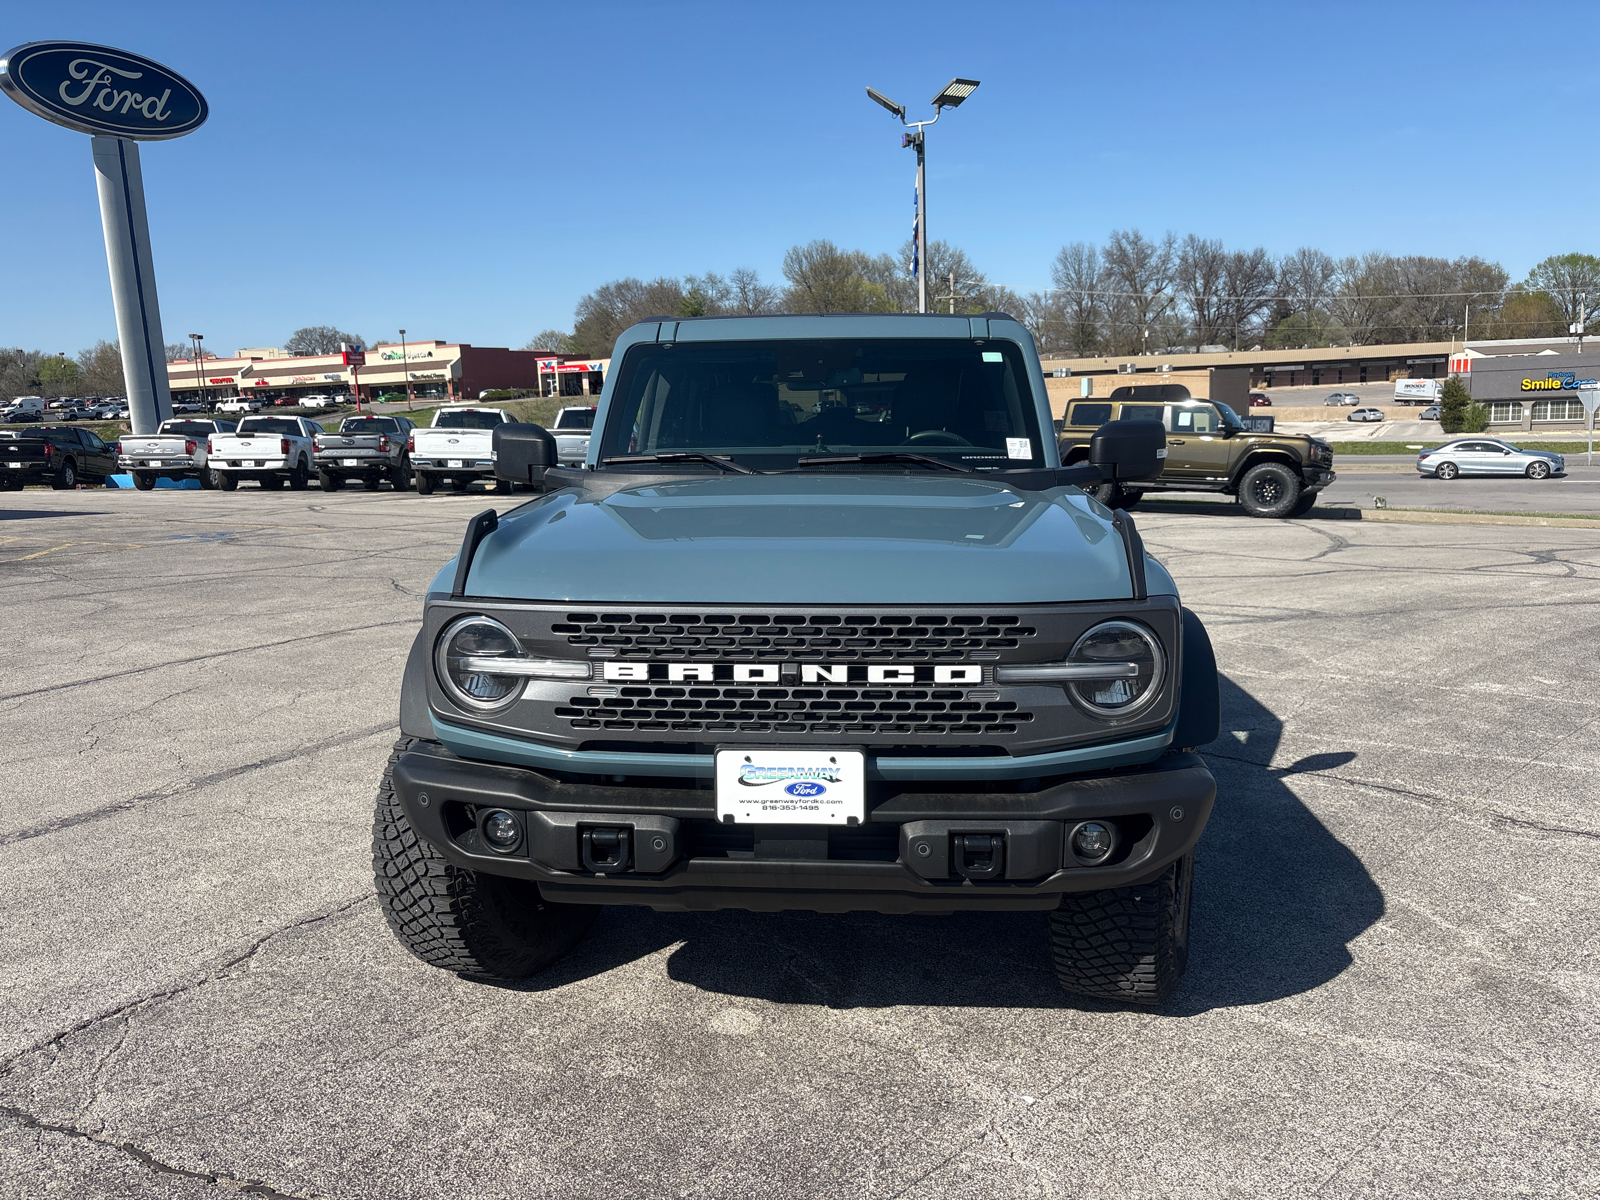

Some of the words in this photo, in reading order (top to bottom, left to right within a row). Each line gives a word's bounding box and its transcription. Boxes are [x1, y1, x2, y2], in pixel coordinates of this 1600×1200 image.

[59, 58, 172, 121] Ford
[1521, 378, 1561, 390] Smile
[603, 661, 982, 684] BRONCO
[740, 764, 841, 780] GREENWAY
[793, 783, 819, 795] Ford
